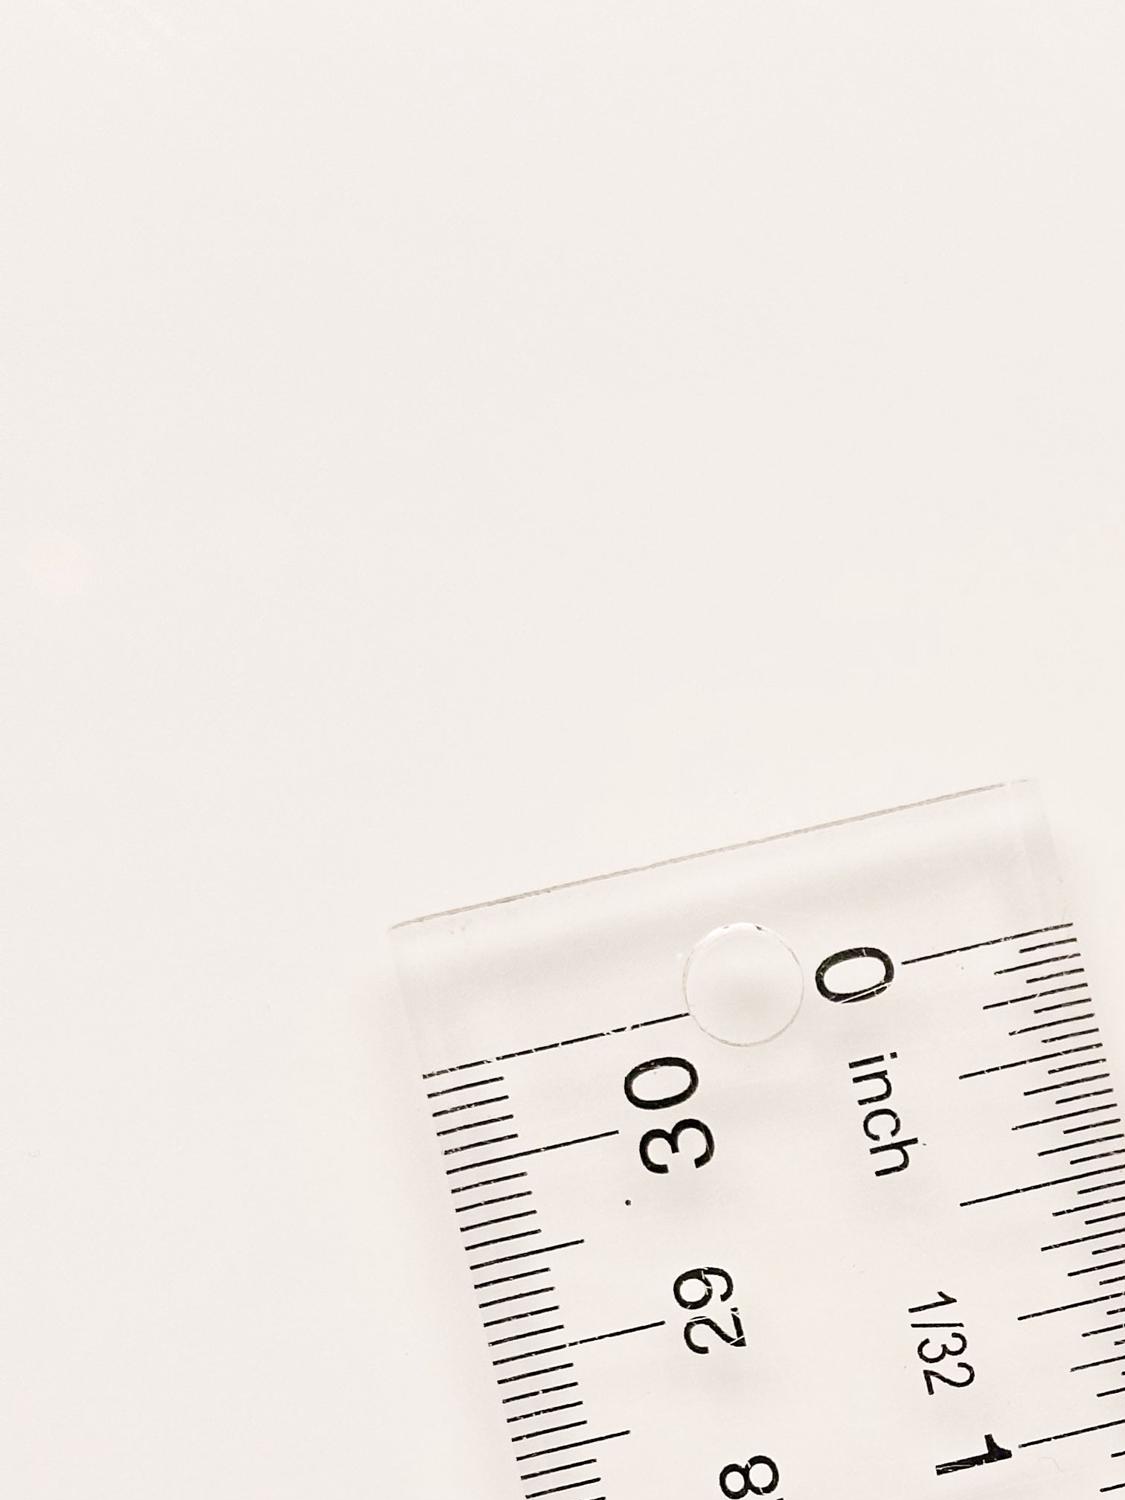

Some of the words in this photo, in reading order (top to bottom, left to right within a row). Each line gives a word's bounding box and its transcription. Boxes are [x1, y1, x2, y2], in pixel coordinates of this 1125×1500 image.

[814, 946, 895, 1004] 0
[623, 1056, 715, 1175] 30
[848, 1051, 919, 1177] inch
[672, 1266, 747, 1355] 29
[907, 1290, 976, 1396] 1/32
[935, 1433, 1013, 1476] 1
